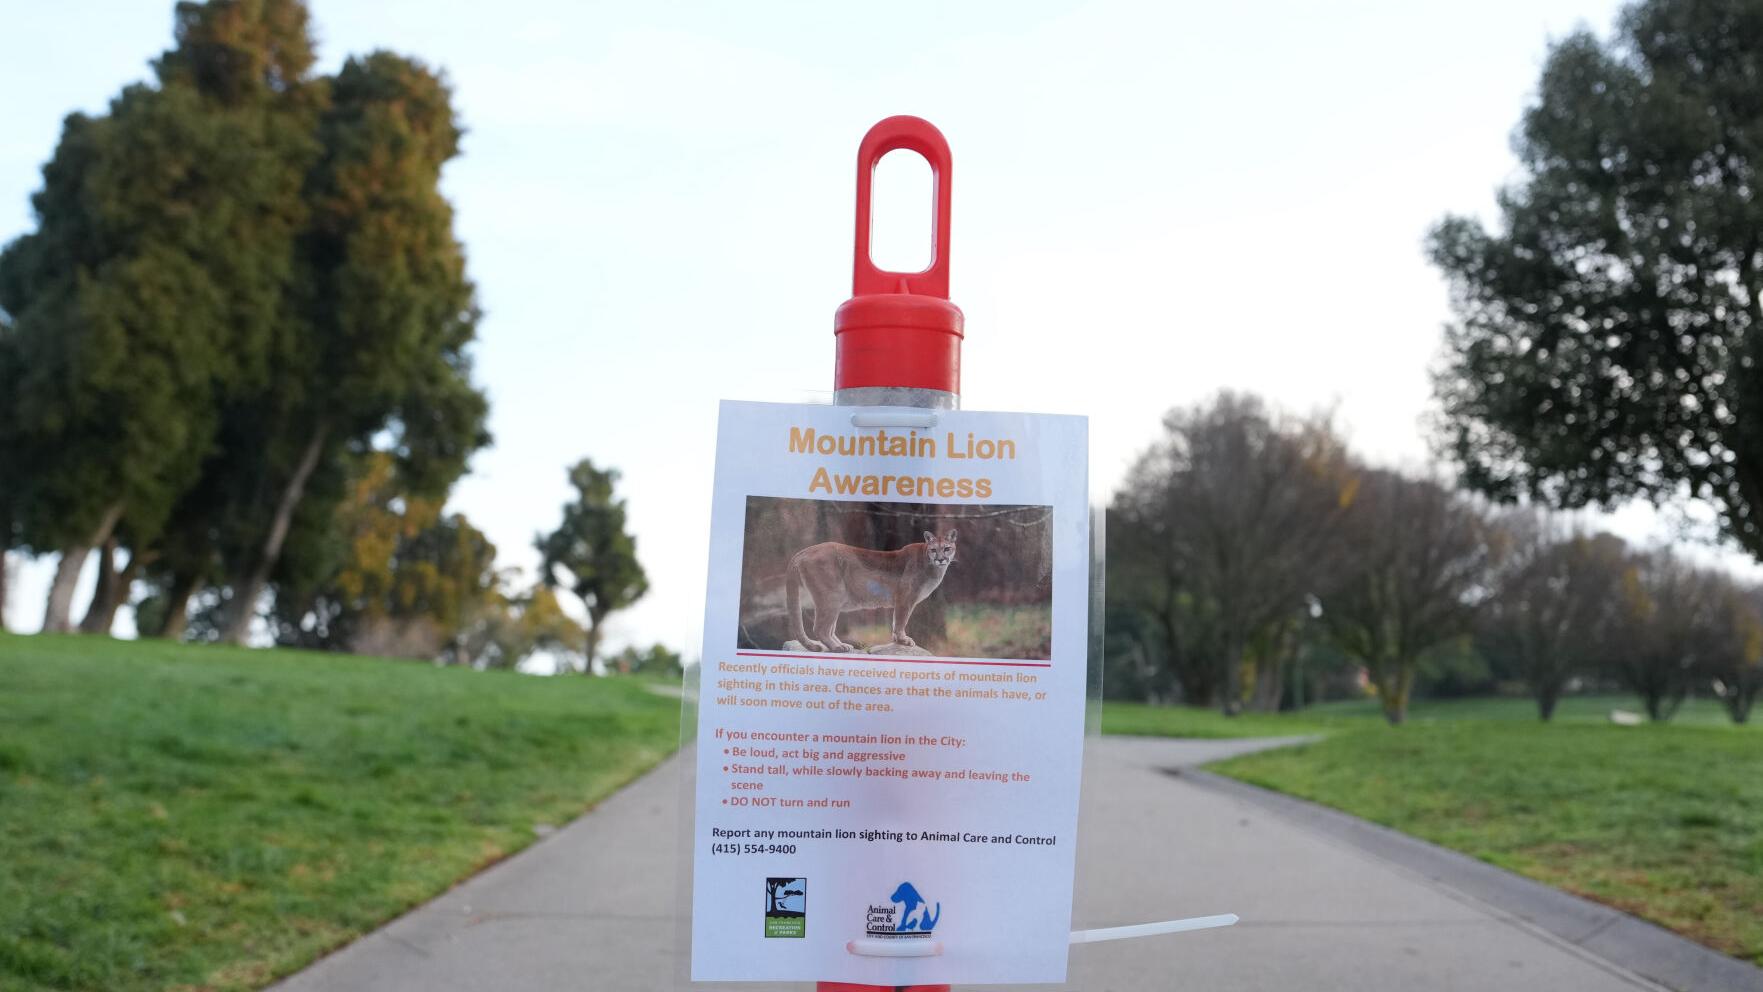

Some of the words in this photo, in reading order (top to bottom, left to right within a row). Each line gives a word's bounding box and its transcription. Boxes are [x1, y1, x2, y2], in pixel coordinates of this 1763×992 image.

[789, 427, 936, 457] Mountain
[947, 432, 1015, 459] Lion
[809, 467, 992, 498] Awareness
[718, 661, 767, 675] Recently
[770, 663, 815, 676] officials
[817, 664, 845, 677] have
[848, 667, 896, 679] received
[899, 669, 941, 681] reports
[944, 669, 956, 681] of
[959, 670, 1013, 682] mountain
[1016, 672, 1037, 683] lion
[717, 678, 762, 691] sighting
[765, 680, 775, 690] in
[779, 680, 799, 692] this
[803, 683, 831, 693] area.
[835, 684, 881, 695] Chances
[885, 687, 904, 696] are
[906, 685, 929, 697] that
[933, 686, 952, 698] the
[955, 687, 998, 699] animals
[1001, 689, 1032, 701] have,
[1035, 691, 1046, 701] or
[717, 696, 736, 706] will
[739, 698, 767, 707] soon
[770, 699, 803, 709] move
[806, 700, 824, 710] out
[827, 700, 840, 711] of
[843, 701, 862, 711] the
[865, 703, 894, 712] area.
[715, 728, 723, 739] If
[726, 731, 748, 743] you
[751, 732, 808, 742] encounter
[811, 734, 819, 743] a
[822, 733, 877, 744] mountain
[880, 734, 901, 745] lion
[904, 735, 915, 745] in
[919, 735, 937, 746] the
[940, 736, 966, 748] City:
[732, 747, 747, 757] Be
[750, 747, 778, 760] loud,
[782, 748, 799, 758] act
[802, 748, 819, 762] big
[822, 749, 844, 760] and
[847, 751, 905, 762] aggressive
[732, 764, 764, 775] Stand
[767, 765, 789, 777] tall,
[792, 765, 823, 777] while
[826, 766, 862, 779] slowly
[866, 767, 908, 780] backing
[912, 770, 941, 781] away
[944, 769, 965, 780] and
[968, 770, 1008, 782] leaving
[1011, 771, 1030, 782] the
[731, 781, 763, 790] scene
[731, 797, 748, 807] DO
[752, 797, 777, 807] NOT
[780, 798, 804, 807] turn
[807, 798, 828, 807] and
[832, 799, 850, 808] run
[712, 827, 751, 839] Report
[754, 829, 774, 839] any
[778, 828, 832, 839] mountain
[835, 828, 856, 840] lion
[859, 829, 902, 841] sighting
[906, 831, 917, 841] to
[920, 831, 960, 842] Animal
[963, 832, 988, 843] Care
[991, 833, 1012, 844] and
[1015, 834, 1056, 846] Control
[712, 843, 741, 856] (415)
[744, 844, 796, 855] 554-9400
[868, 905, 896, 914] Animal
[867, 914, 885, 922] Care
[885, 914, 892, 923] &
[867, 922, 896, 931] Control
